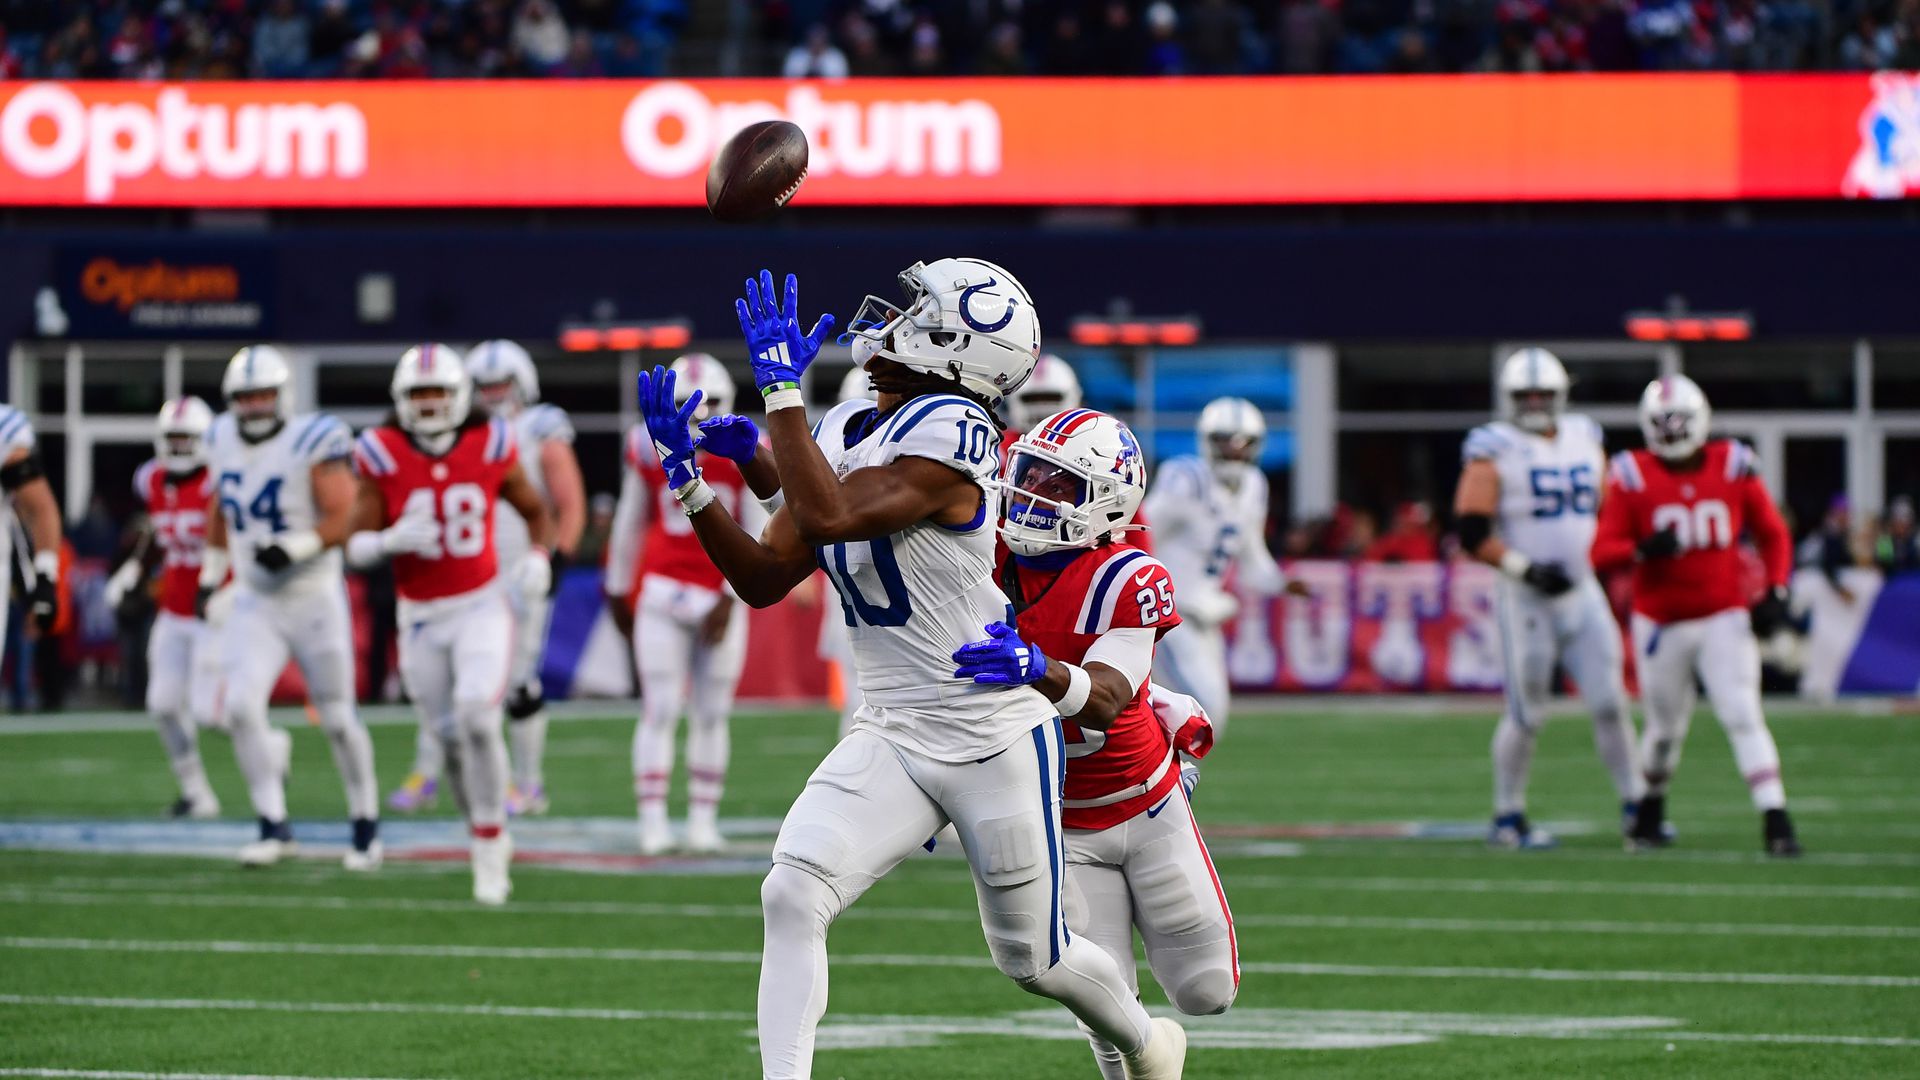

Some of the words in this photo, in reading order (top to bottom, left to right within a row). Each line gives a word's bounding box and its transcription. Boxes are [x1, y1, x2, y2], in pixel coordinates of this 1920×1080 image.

[0, 81, 367, 203] Optum
[620, 81, 1002, 179] Otum
[953, 420, 989, 465] 10
[1031, 438, 1058, 454] PATRIOTS
[1529, 465, 1592, 518] 56
[1136, 576, 1174, 625] 25
